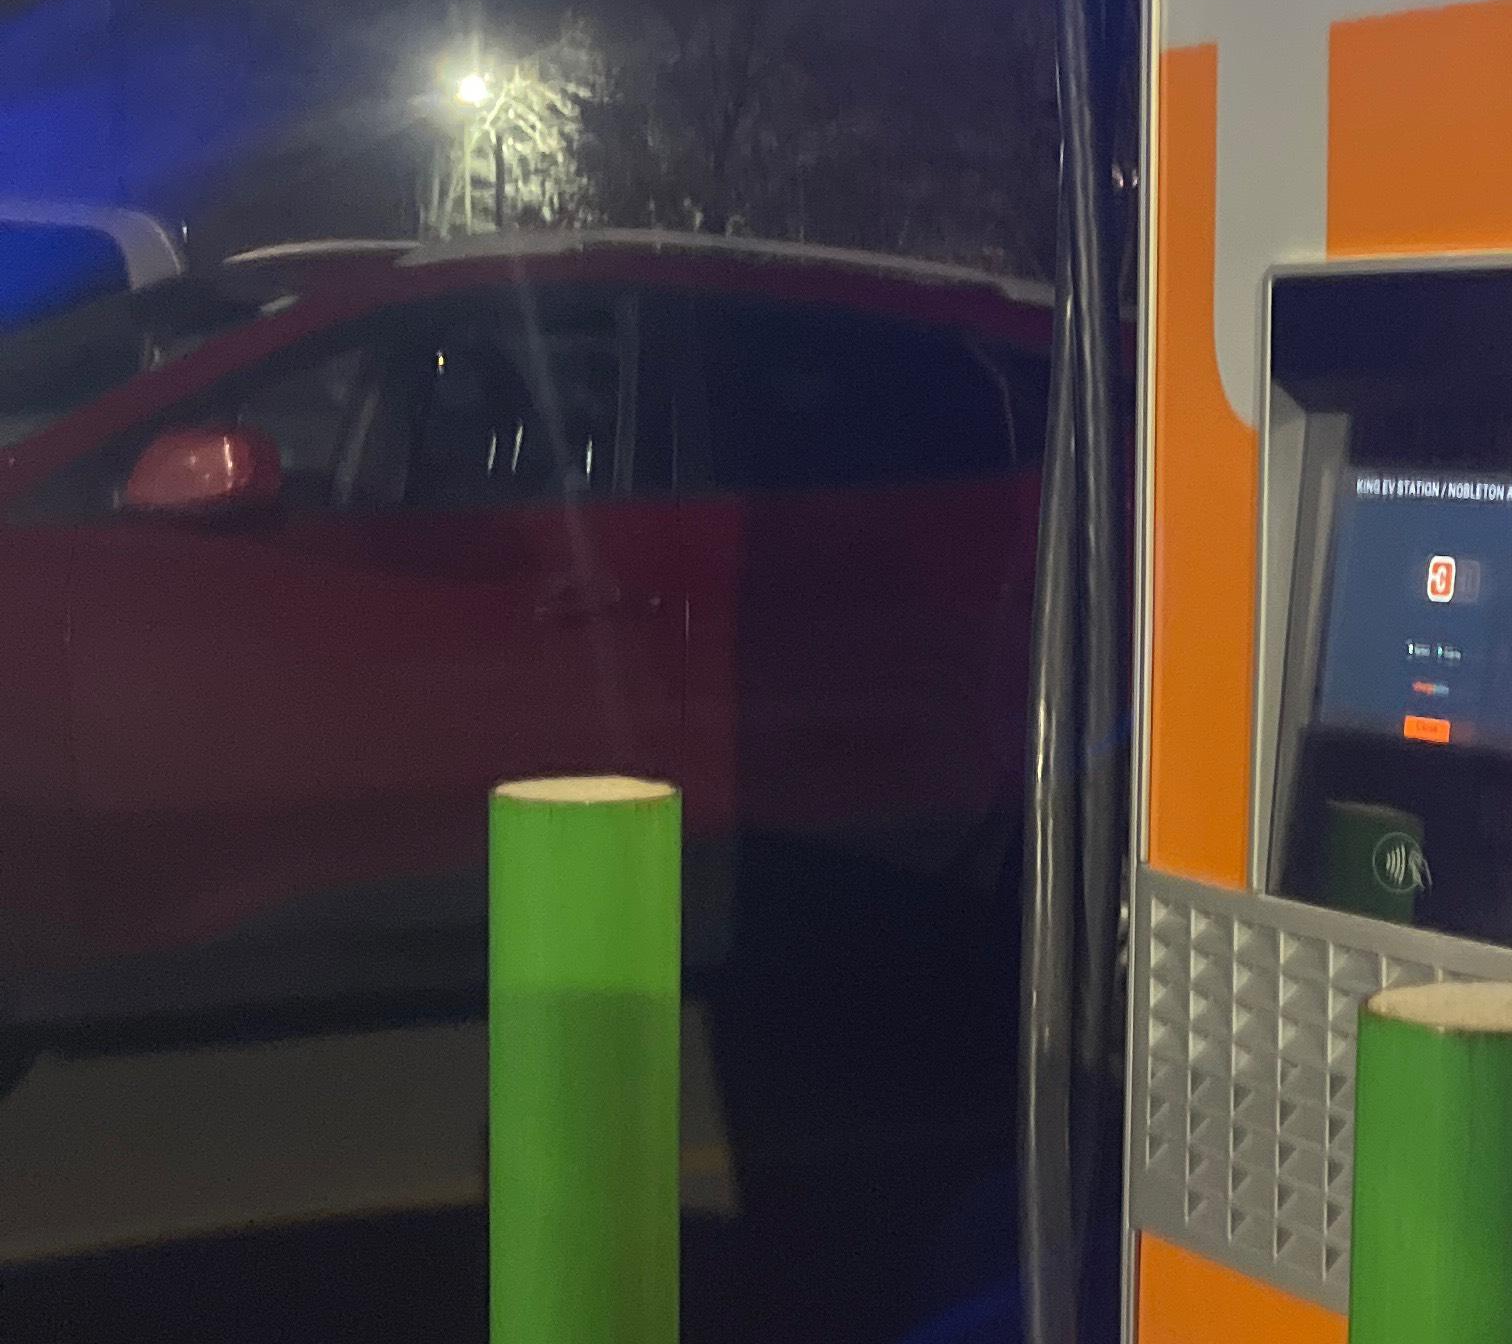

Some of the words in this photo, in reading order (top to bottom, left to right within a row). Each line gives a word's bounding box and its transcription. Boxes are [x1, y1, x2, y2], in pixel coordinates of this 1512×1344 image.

[1356, 478, 1381, 496] KING
[1382, 479, 1397, 497] EV
[1397, 479, 1440, 498] STATION
[1440, 481, 1447, 499] /
[1448, 482, 1504, 502] NOBLETON
